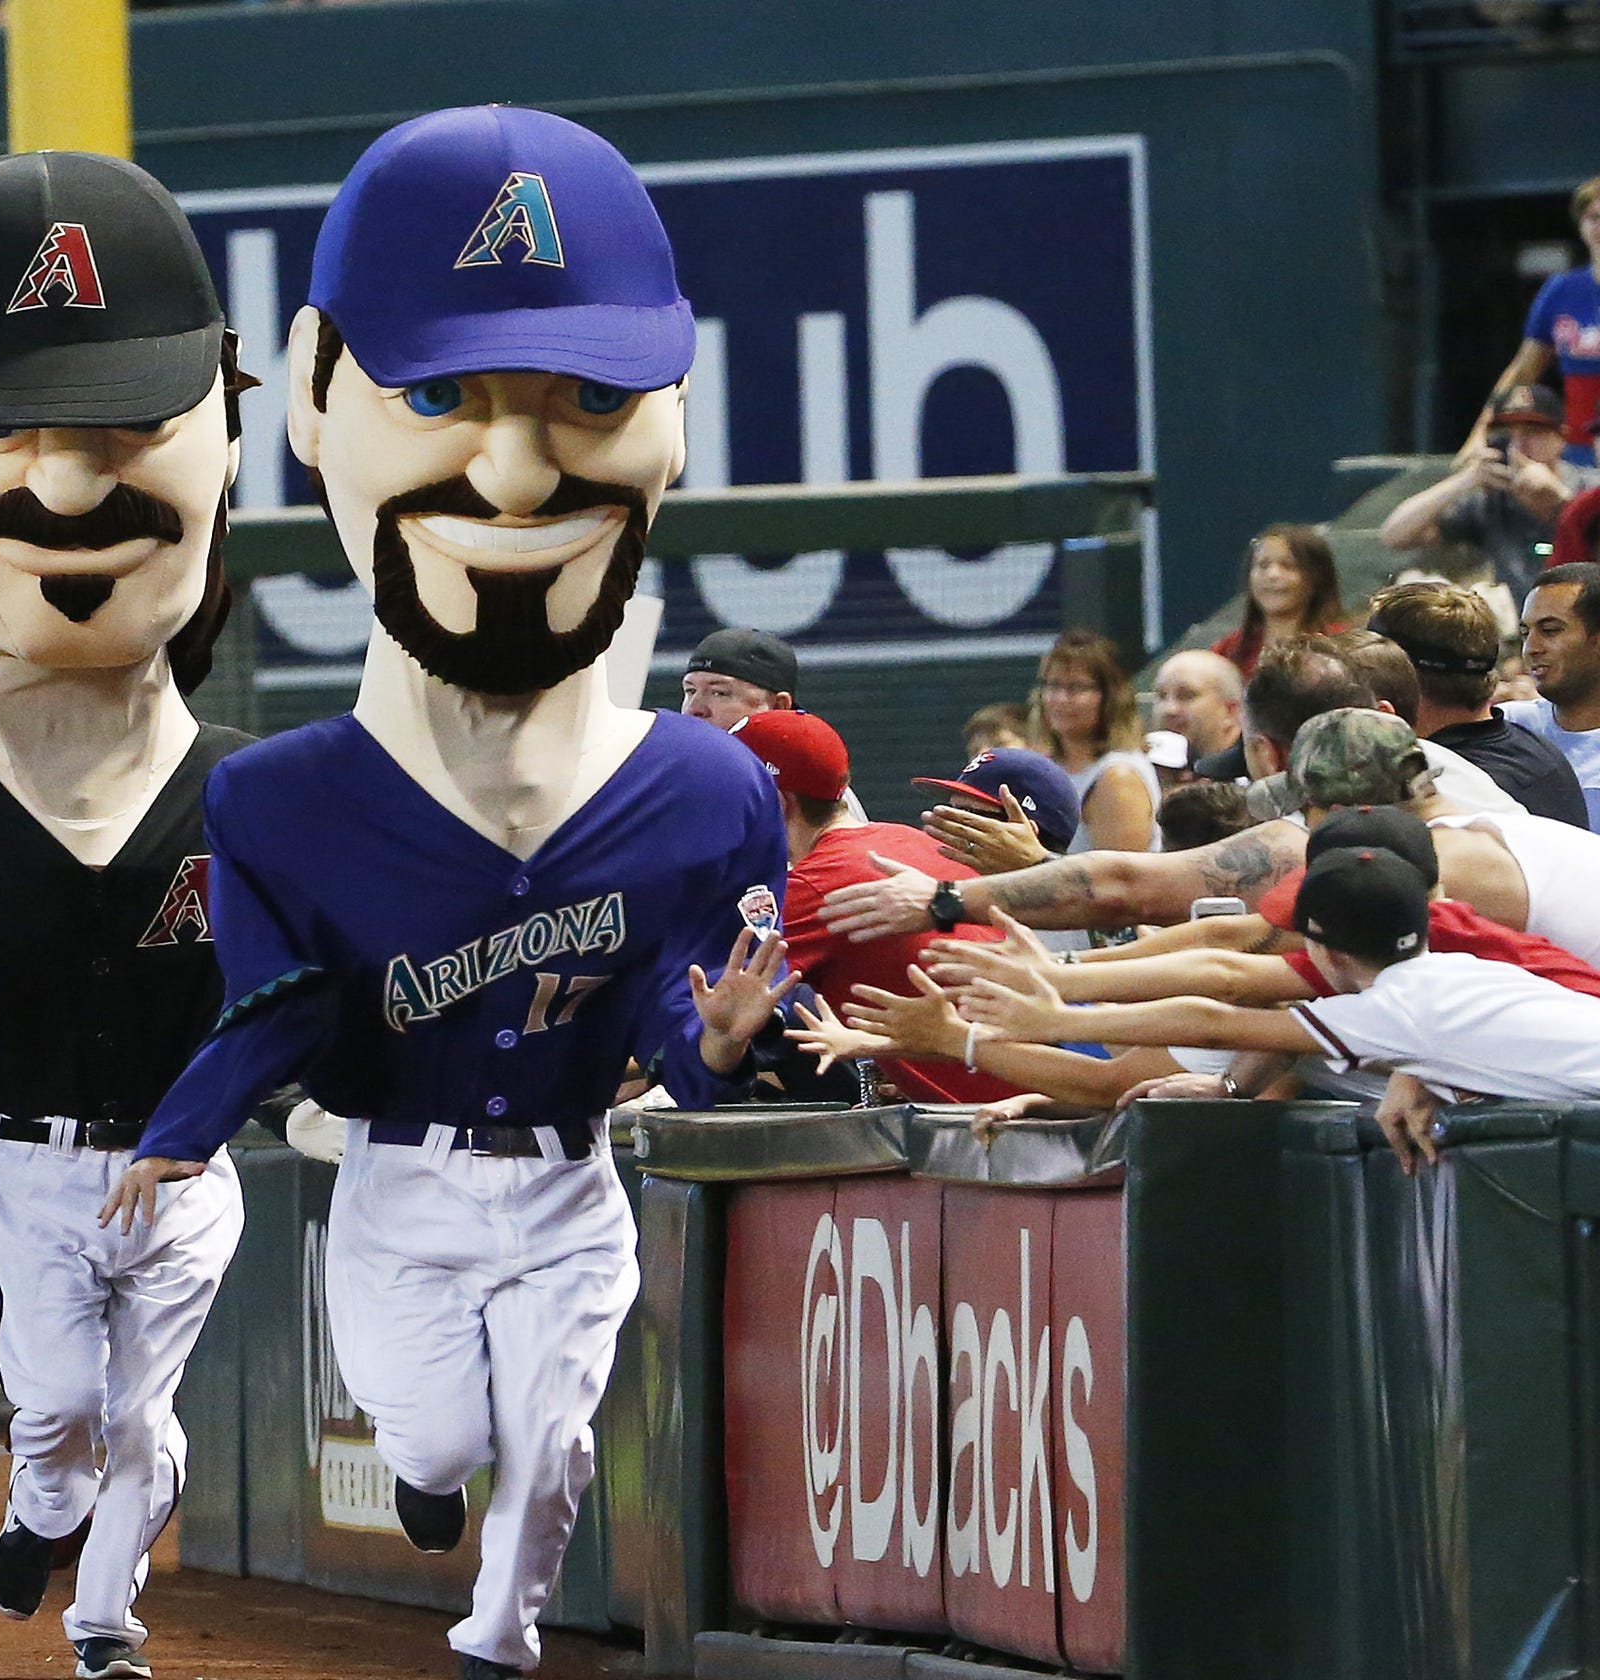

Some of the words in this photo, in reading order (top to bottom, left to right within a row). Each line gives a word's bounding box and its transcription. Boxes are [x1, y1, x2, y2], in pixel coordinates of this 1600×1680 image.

[6, 222, 106, 314] A
[453, 171, 565, 269] A
[384, 891, 626, 1033] ARIZONA
[523, 972, 613, 1036] 17
[801, 1212, 1098, 1603] @Dbacks
